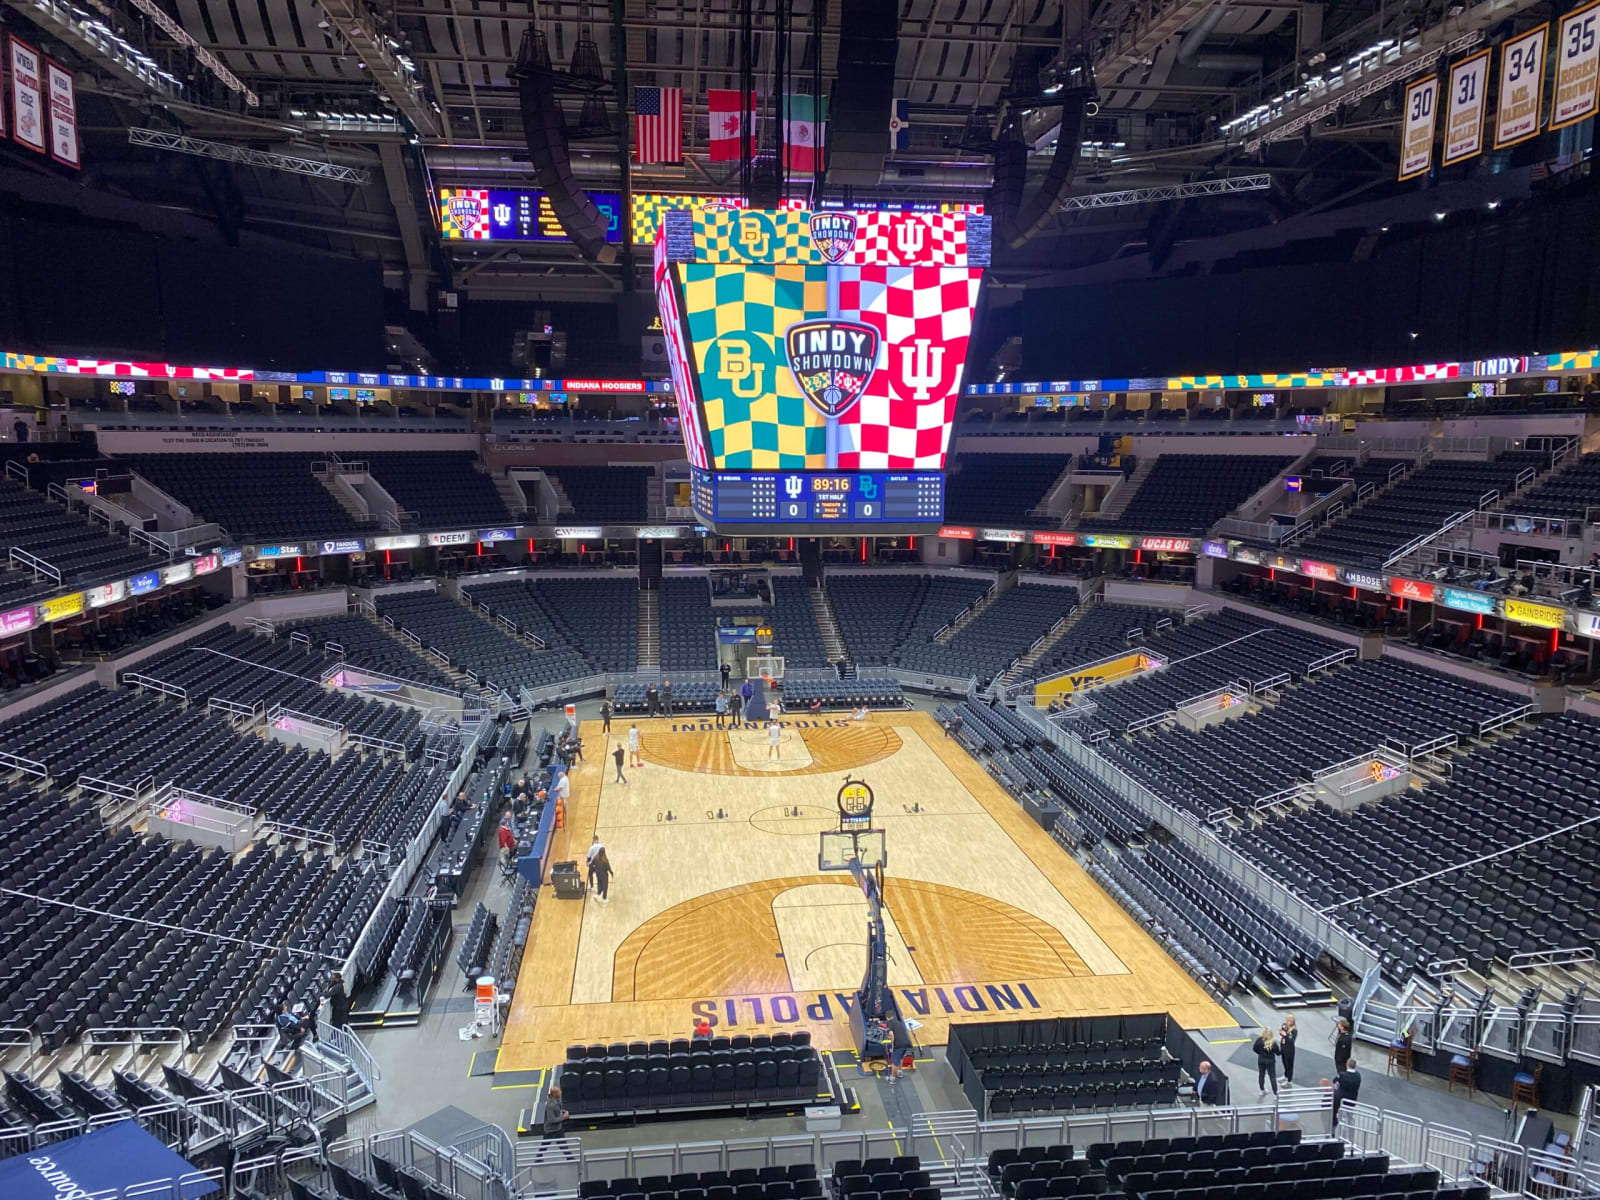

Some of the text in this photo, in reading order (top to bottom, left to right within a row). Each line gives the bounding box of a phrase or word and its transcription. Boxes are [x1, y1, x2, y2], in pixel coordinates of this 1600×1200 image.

[1567, 15, 1596, 58] 35
[1508, 40, 1537, 81] 34
[1458, 71, 1476, 104] 31
[1411, 87, 1432, 121] 30
[452, 200, 477, 209] INDY
[816, 217, 850, 231] INDY
[739, 218, 769, 257] BU
[813, 230, 854, 240] SHOWDOWN
[799, 330, 866, 355] INDY
[717, 339, 765, 398] BU
[793, 354, 872, 372] SHOWDOWN
[1481, 358, 1520, 376] INDY
[567, 382, 642, 390] INDIANA HOOSIERS
[663, 382, 670, 391] 0
[814, 479, 849, 491] 89:16
[789, 504, 798, 516] 0
[864, 504, 873, 516] 0
[440, 534, 465, 543] DEEM
[1142, 538, 1191, 550] LUCAS OIL
[1345, 572, 1381, 587] AMBROSE
[1517, 605, 1562, 624] GAINBRIDGE
